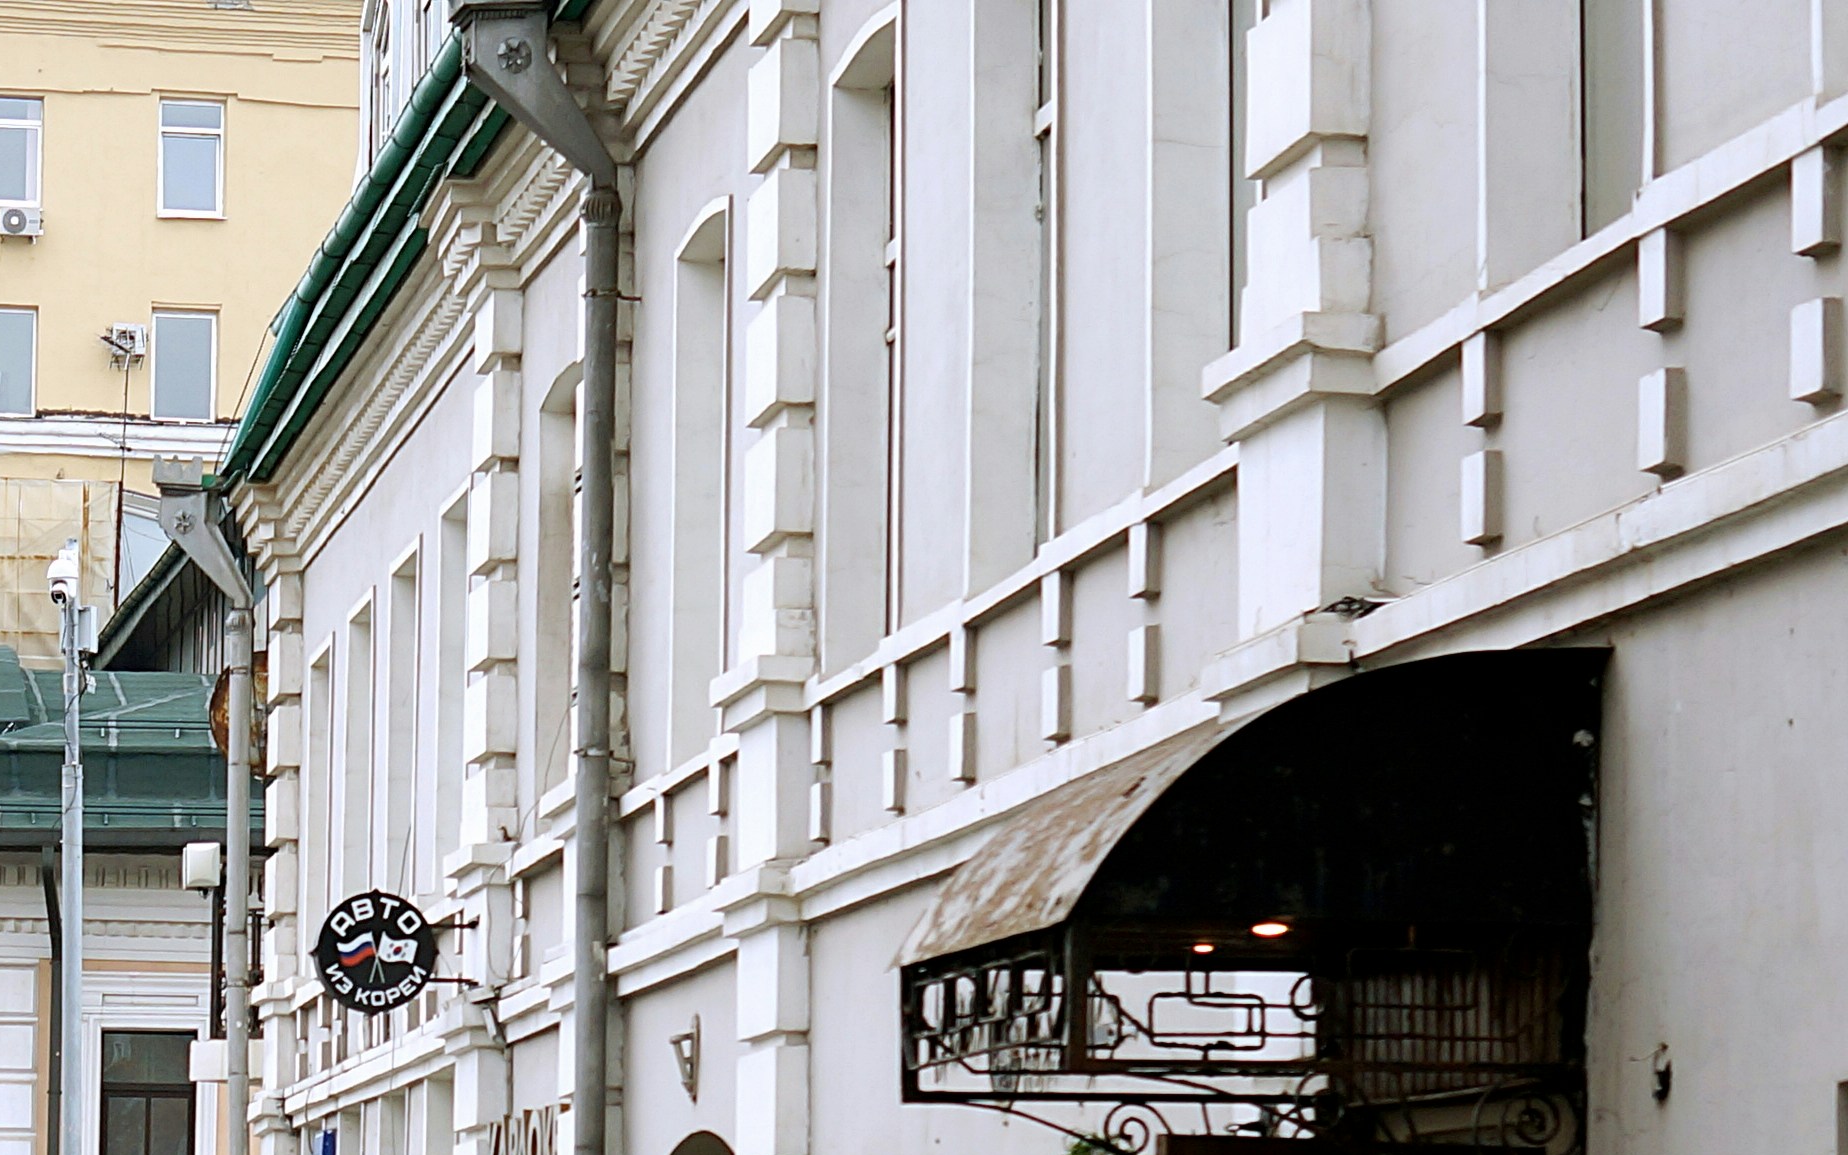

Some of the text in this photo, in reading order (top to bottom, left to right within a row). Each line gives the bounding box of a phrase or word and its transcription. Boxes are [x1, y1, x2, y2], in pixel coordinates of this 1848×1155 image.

[330, 896, 422, 937] АВТО
[325, 962, 427, 1006] ИЗ КОРЕИ
